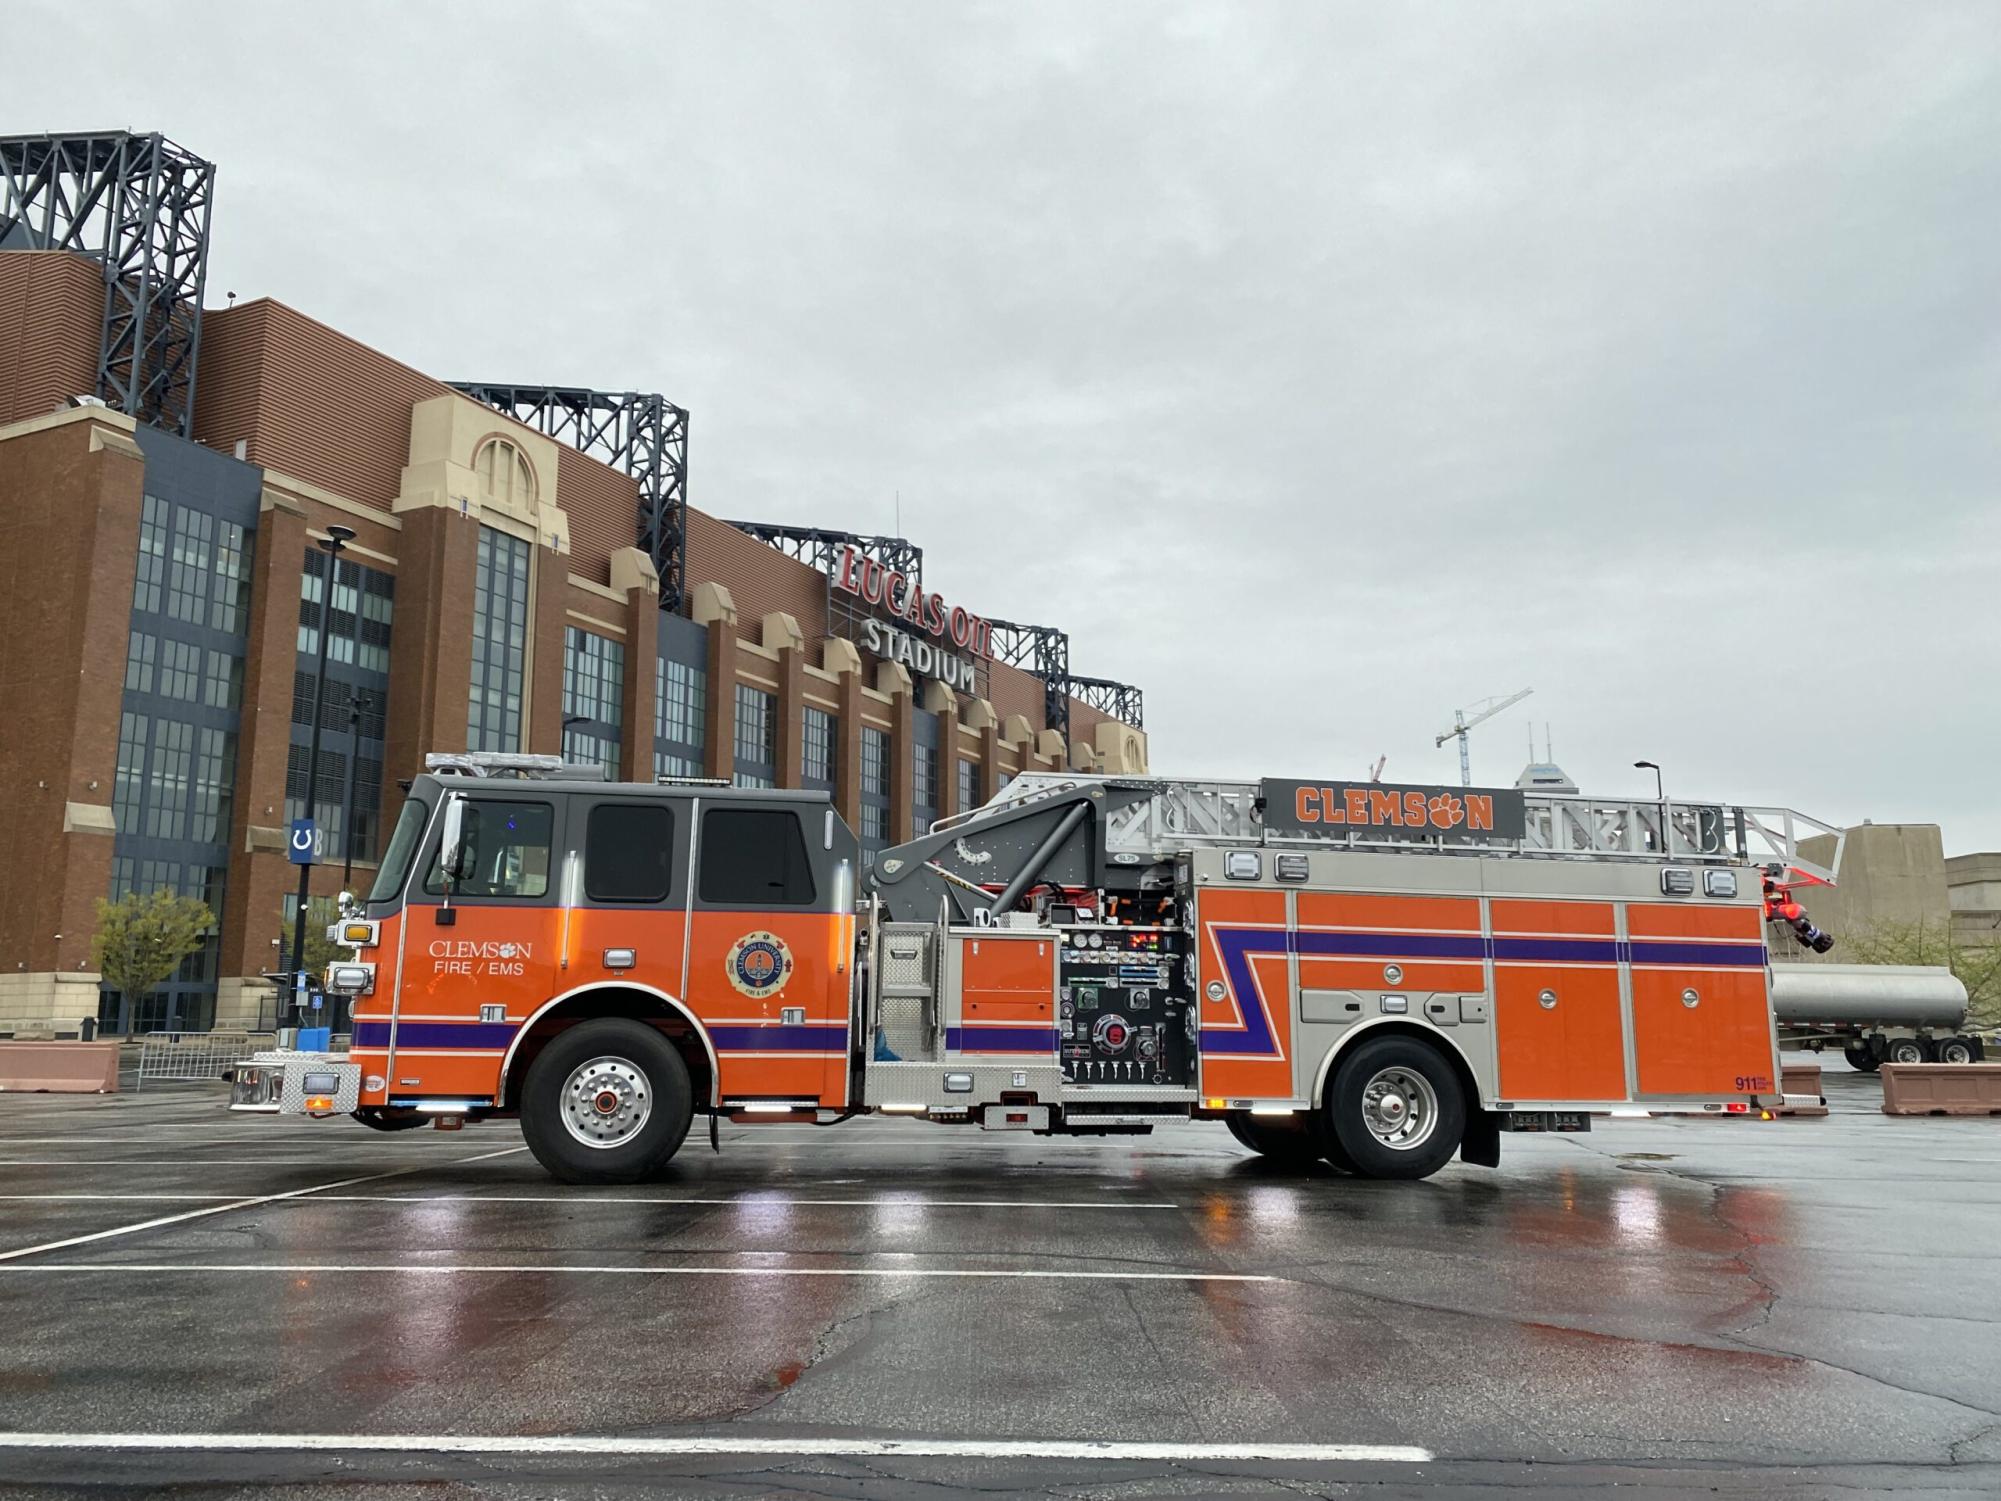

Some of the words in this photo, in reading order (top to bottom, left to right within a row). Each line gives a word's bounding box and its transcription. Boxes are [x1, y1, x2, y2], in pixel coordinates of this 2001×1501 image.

[834, 542, 944, 636] LUCAS
[947, 606, 994, 662] OIL
[861, 618, 976, 694] STADIUM
[433, 961, 473, 975] FIRE
[488, 962, 524, 976] EMS
[1736, 1076, 1757, 1090] 911
